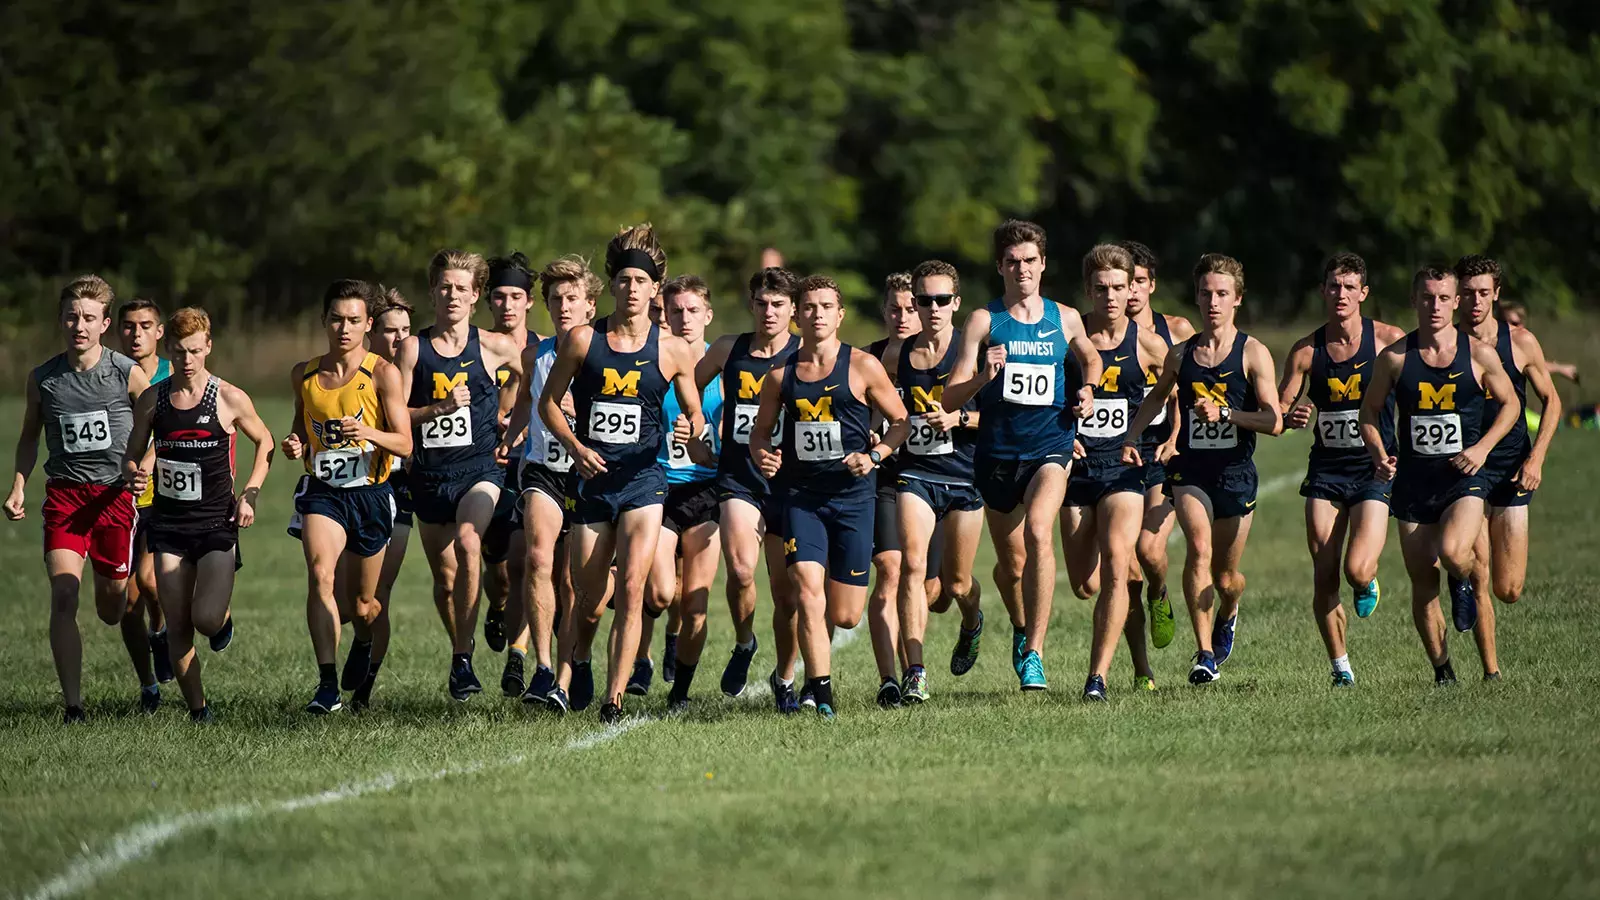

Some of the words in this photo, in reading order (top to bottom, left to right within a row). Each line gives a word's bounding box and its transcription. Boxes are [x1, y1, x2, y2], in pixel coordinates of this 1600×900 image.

[1009, 340, 1054, 356] MIDWEST
[432, 372, 468, 399] M
[601, 367, 642, 398] M
[738, 370, 767, 399] M
[1010, 373, 1048, 396] 510
[1191, 381, 1229, 407] M
[1327, 374, 1361, 402] M
[910, 385, 944, 413] M
[1418, 381, 1457, 410] M
[795, 396, 833, 422] M
[1082, 408, 1124, 429] 298
[64, 420, 107, 444] 543
[324, 419, 344, 444] S
[426, 416, 467, 438] 293
[593, 411, 636, 435] 295
[909, 424, 949, 446] 294
[1191, 418, 1234, 440] 282
[1322, 419, 1361, 440] 273
[1414, 423, 1458, 446] 292
[803, 431, 832, 452] 311
[162, 467, 196, 492] 581
[320, 456, 360, 481] 527
